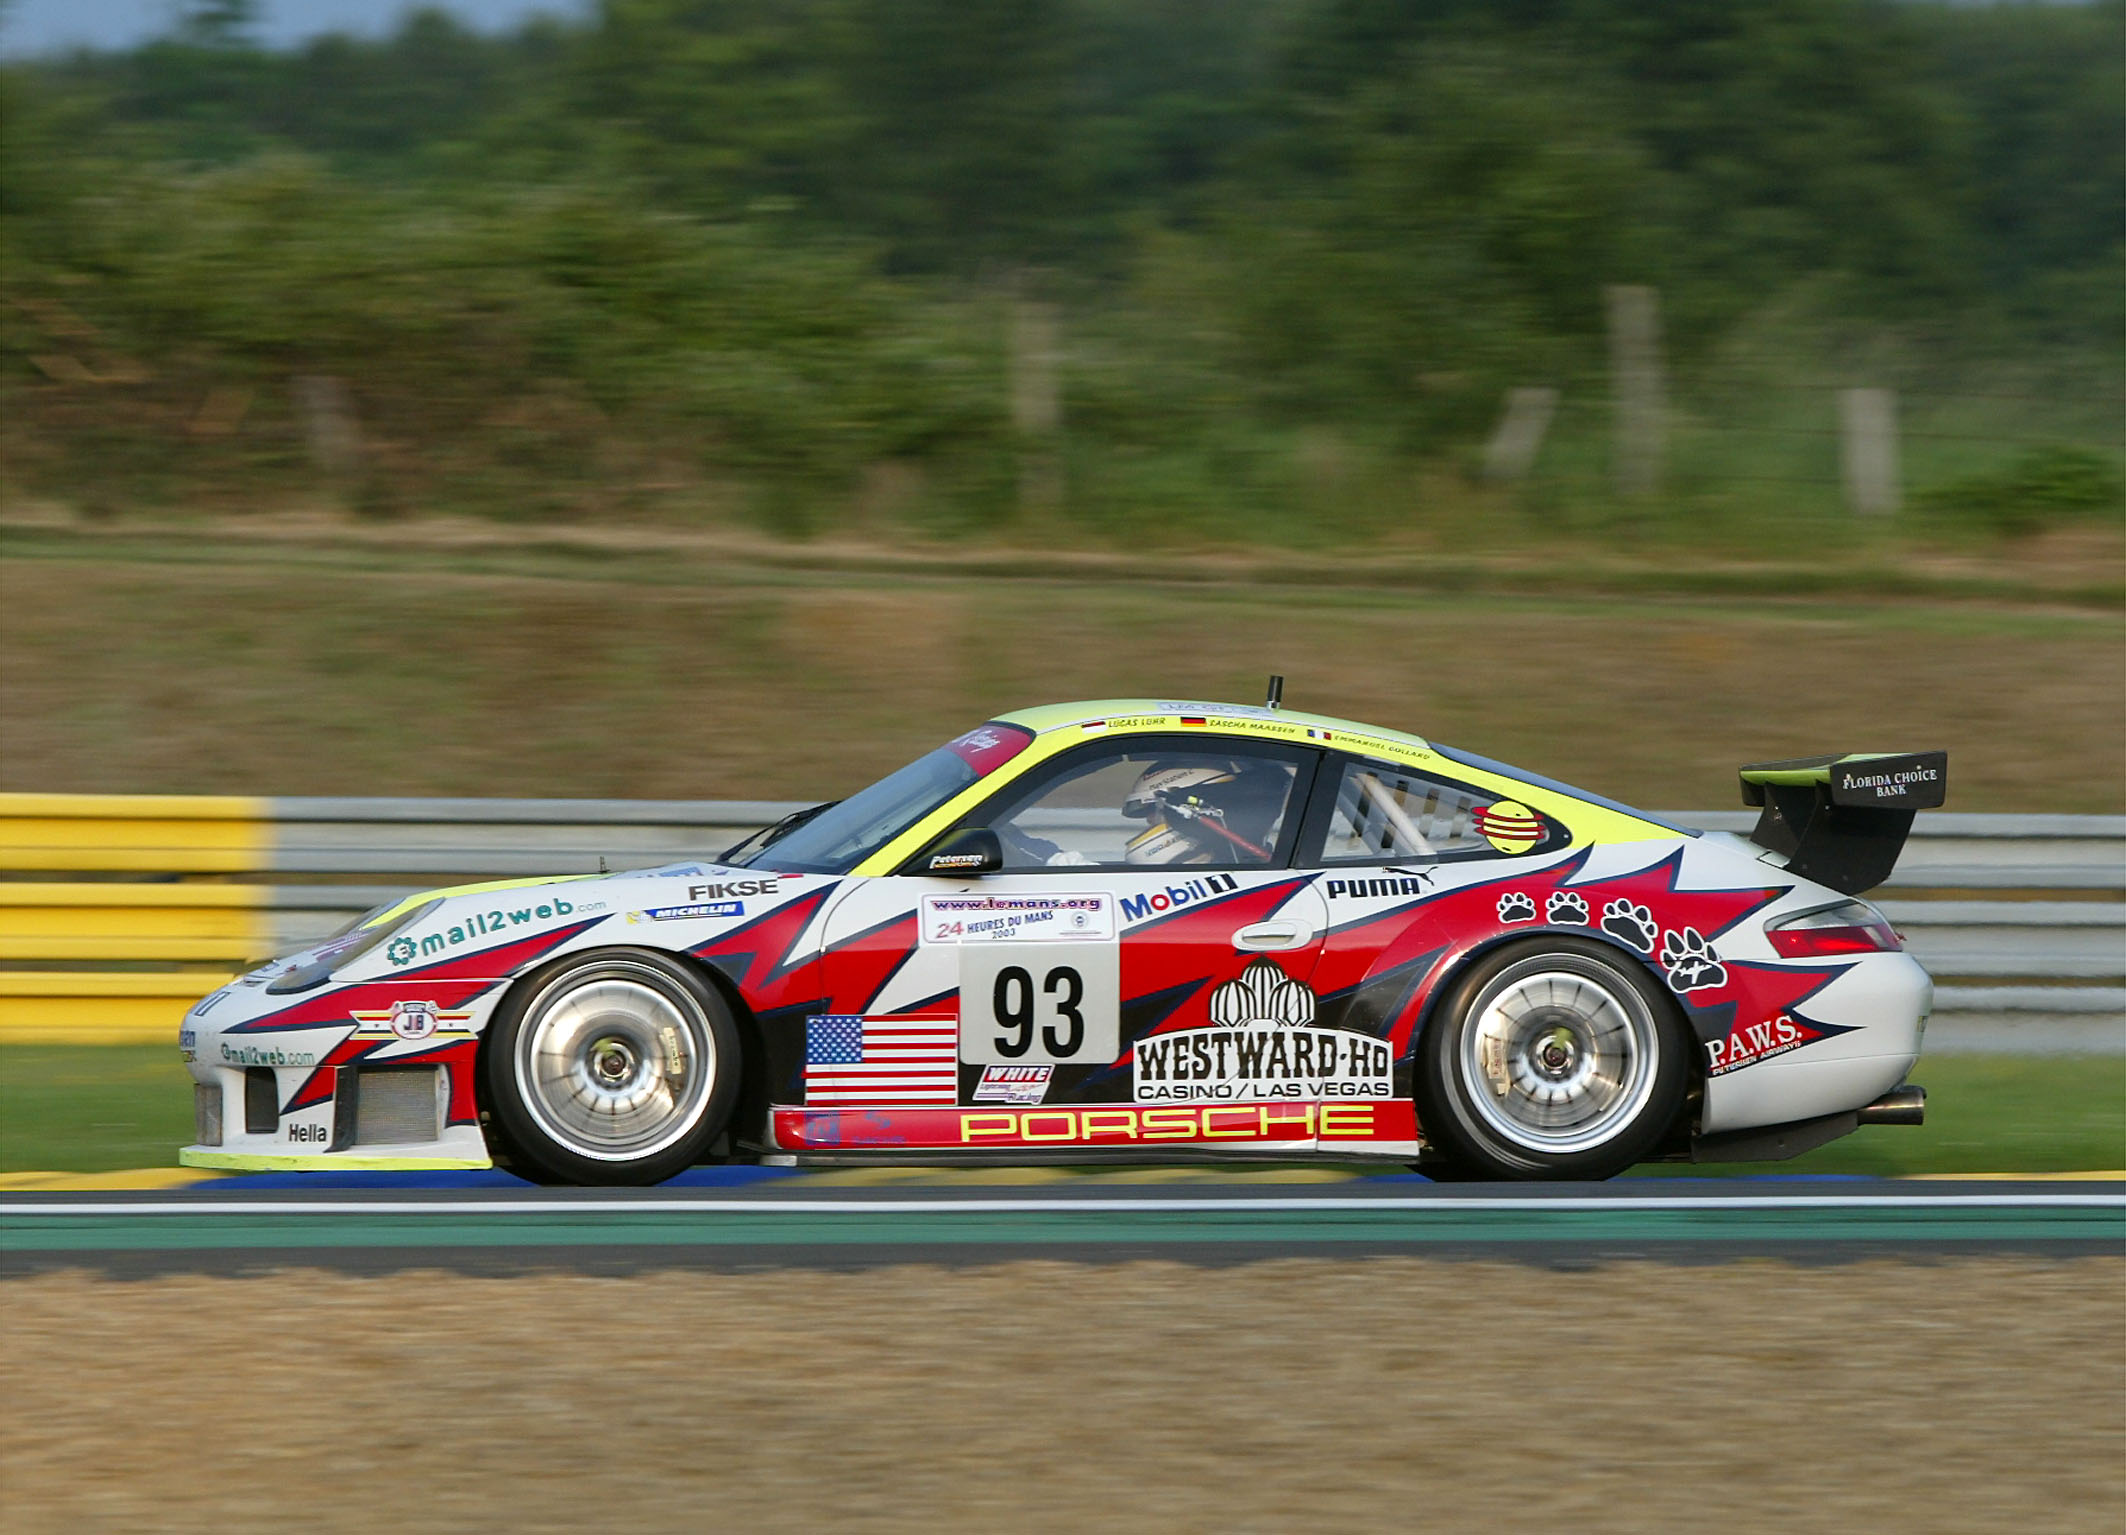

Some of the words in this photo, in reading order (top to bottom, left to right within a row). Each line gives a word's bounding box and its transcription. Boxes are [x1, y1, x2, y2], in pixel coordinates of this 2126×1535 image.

[1108, 719, 1138, 728] LUCAS
[1209, 719, 1247, 730] SASCHA
[1843, 774, 1892, 789] FLORIDA
[1894, 765, 1938, 784] CHOICE
[1876, 784, 1907, 797] BANK
[688, 879, 779, 901] FIKSE
[1119, 879, 1208, 922] Mobil
[1207, 873, 1235, 893] 1
[1326, 878, 1420, 899] PUMA
[655, 903, 737, 918] MICHELIN
[930, 897, 1102, 912] www.lemans.org
[936, 921, 964, 939] 24
[967, 918, 1005, 934] HEURES
[1008, 915, 1022, 927] DU
[1025, 910, 1054, 925] MANS
[992, 929, 1016, 939] 2003
[993, 965, 1085, 1058] 93
[1705, 1015, 1803, 1068] P.A.W.S.
[985, 1066, 1050, 1081] WHITE
[1138, 1084, 1233, 1100] CASINO
[1308, 1082, 1390, 1097] VEGAS
[289, 1124, 327, 1142] Hella
[960, 1105, 1374, 1143] PORSCHE
